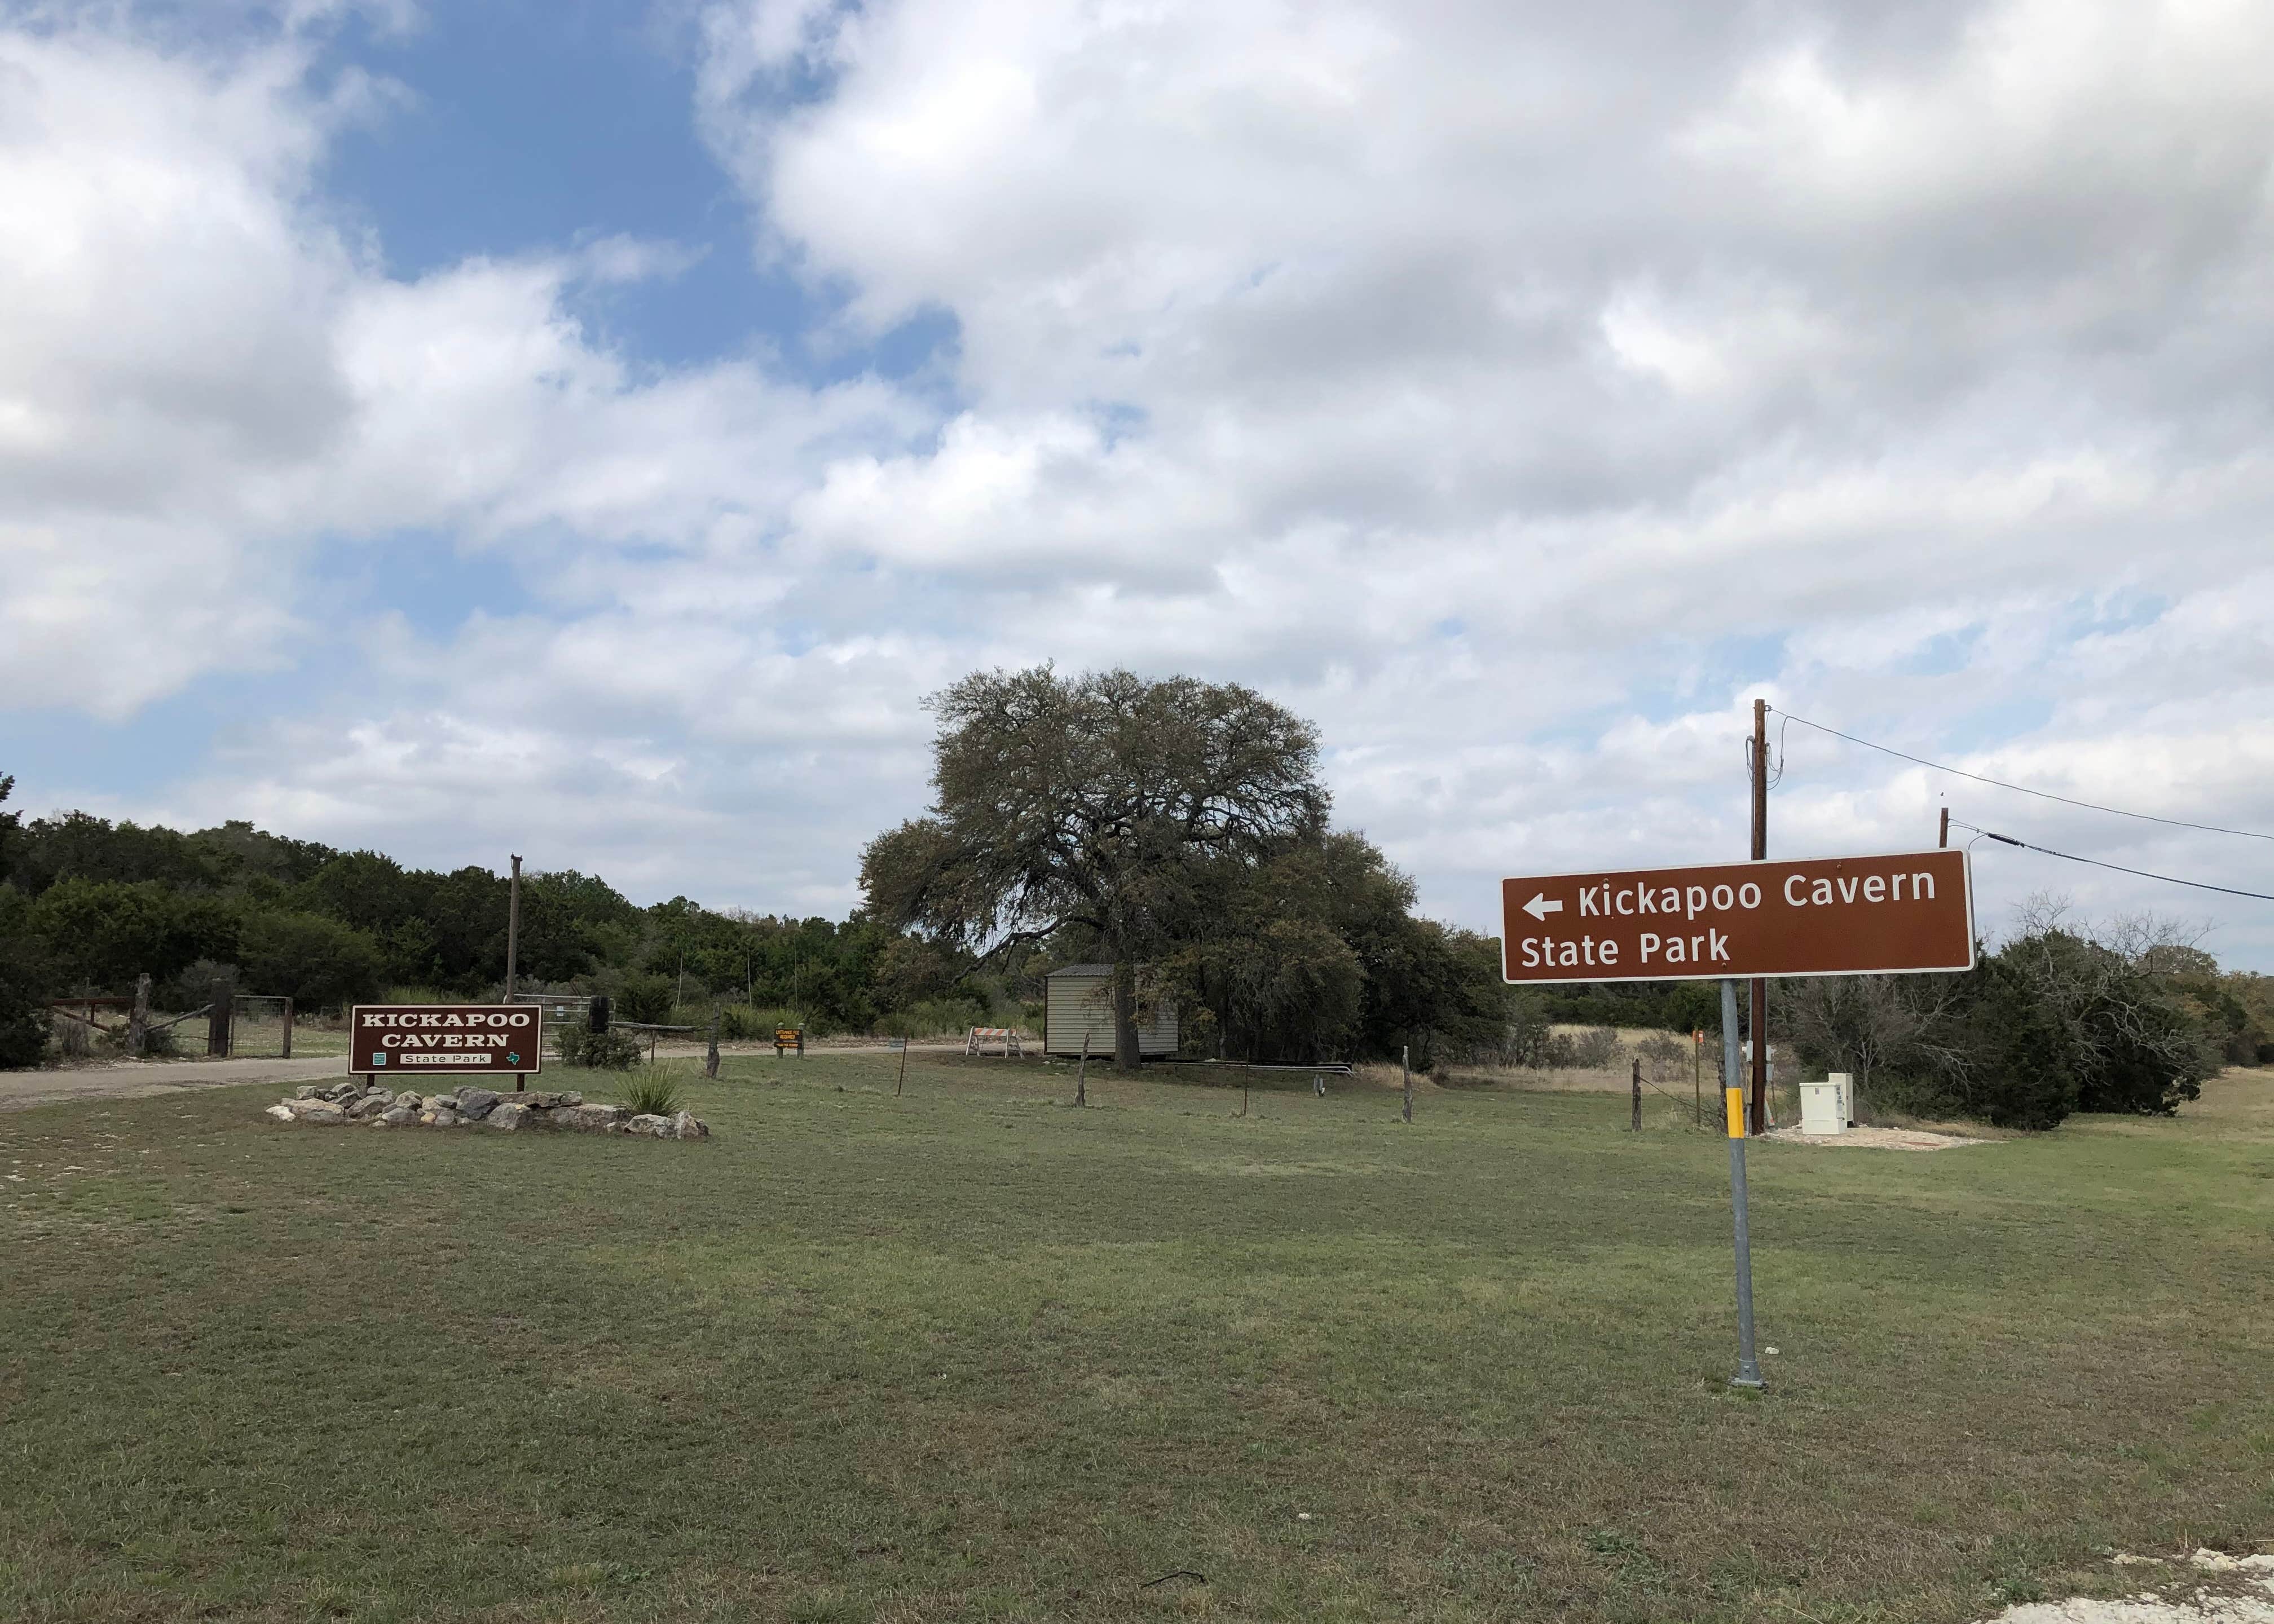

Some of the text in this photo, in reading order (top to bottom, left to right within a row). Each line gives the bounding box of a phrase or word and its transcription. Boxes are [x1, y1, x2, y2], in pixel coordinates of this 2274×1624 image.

[1580, 872, 1935, 920] Kickapoo Cavern
[1522, 928, 1730, 967] State Park
[362, 1014, 530, 1027] KICKAPOO
[382, 1034, 509, 1047] CAVERN
